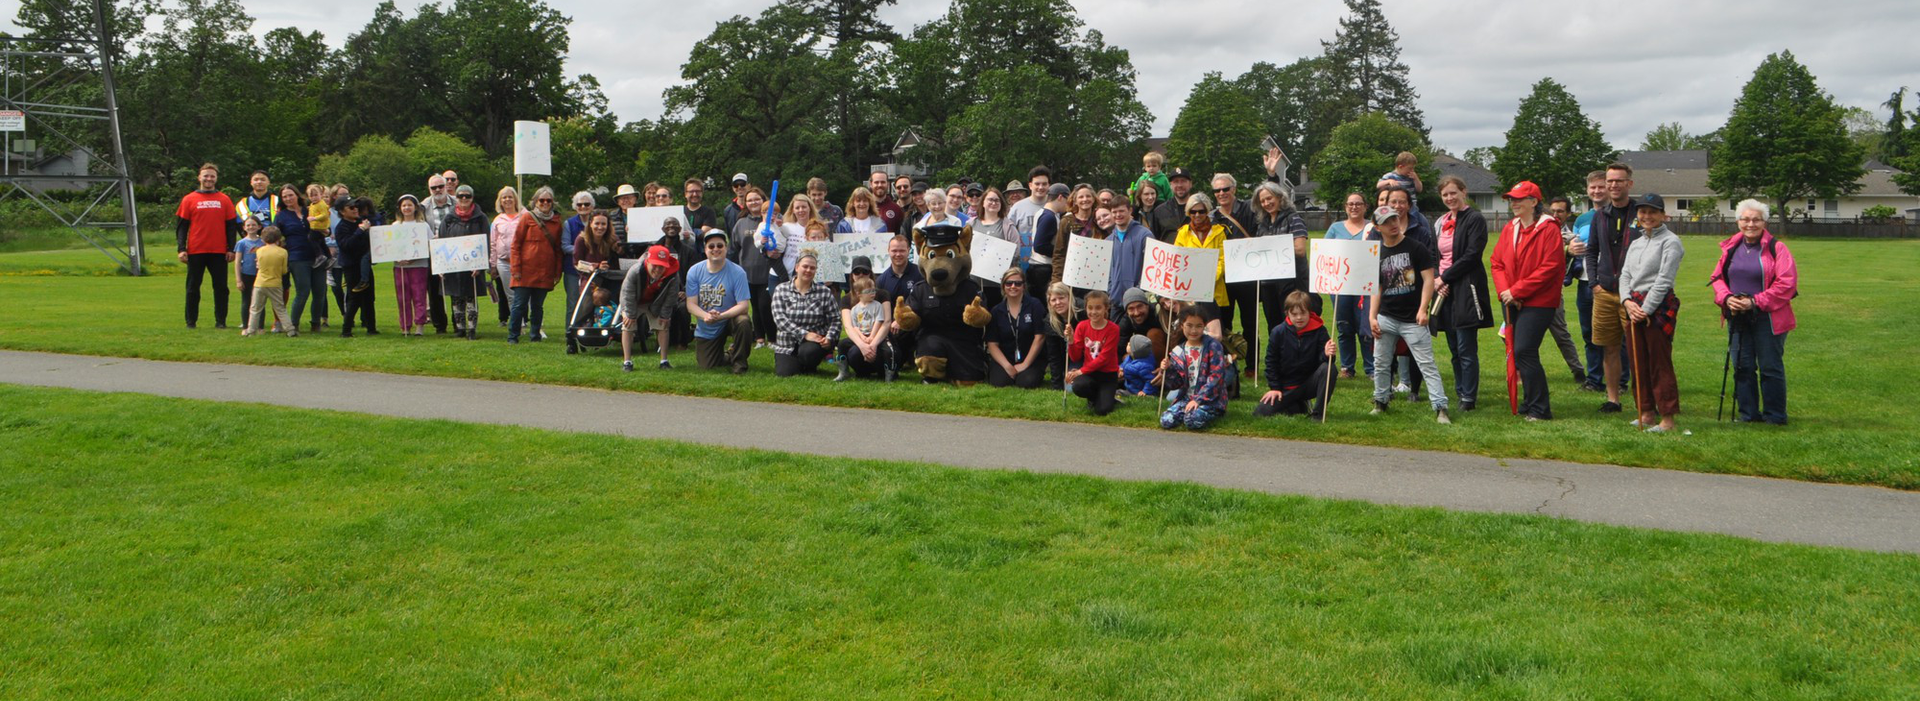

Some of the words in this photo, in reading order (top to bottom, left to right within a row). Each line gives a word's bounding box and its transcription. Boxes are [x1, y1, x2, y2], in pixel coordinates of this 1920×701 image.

[838, 236, 871, 254] TEAM
[1245, 247, 1292, 268] OTIS
[1145, 266, 1193, 291] CREW
[1314, 274, 1344, 292] CREW
